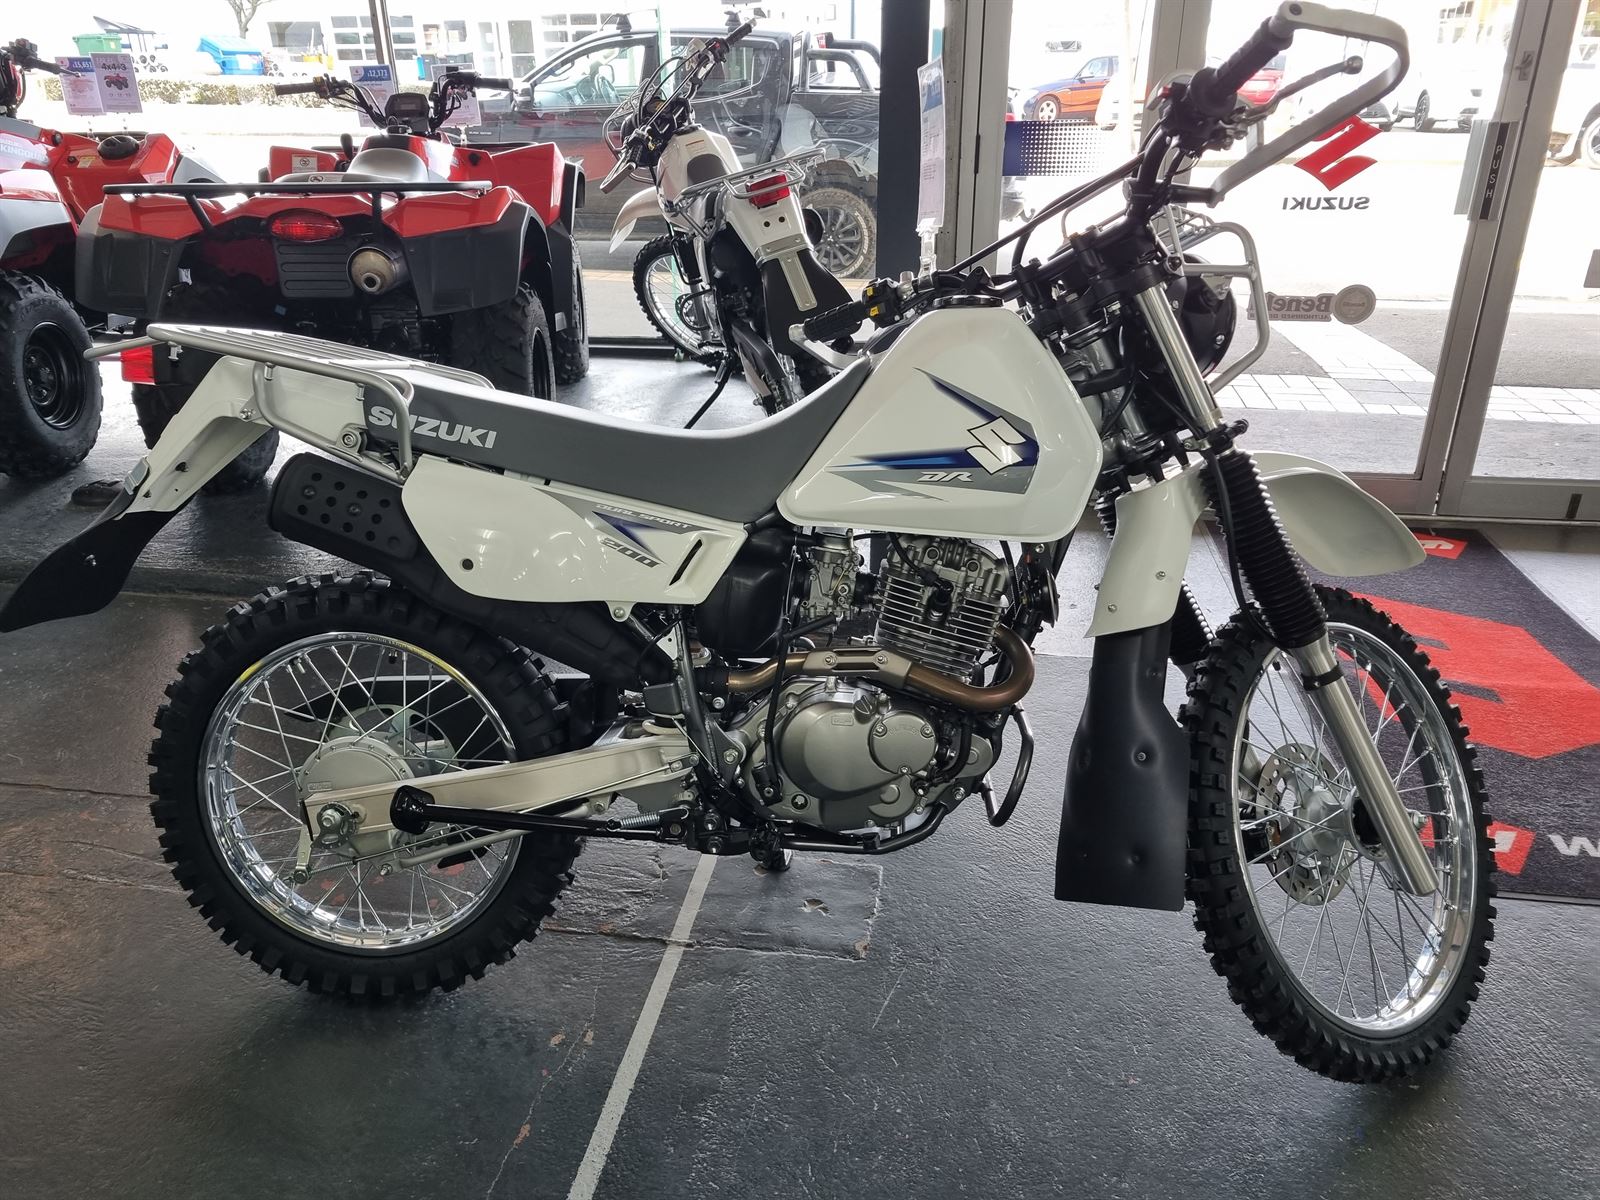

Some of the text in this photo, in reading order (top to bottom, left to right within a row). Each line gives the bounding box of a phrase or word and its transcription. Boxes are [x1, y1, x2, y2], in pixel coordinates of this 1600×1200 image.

[1486, 145, 1503, 199] PUSH
[917, 471, 974, 482] DR
[638, 511, 692, 530] SPORT
[600, 537, 660, 569] 200
